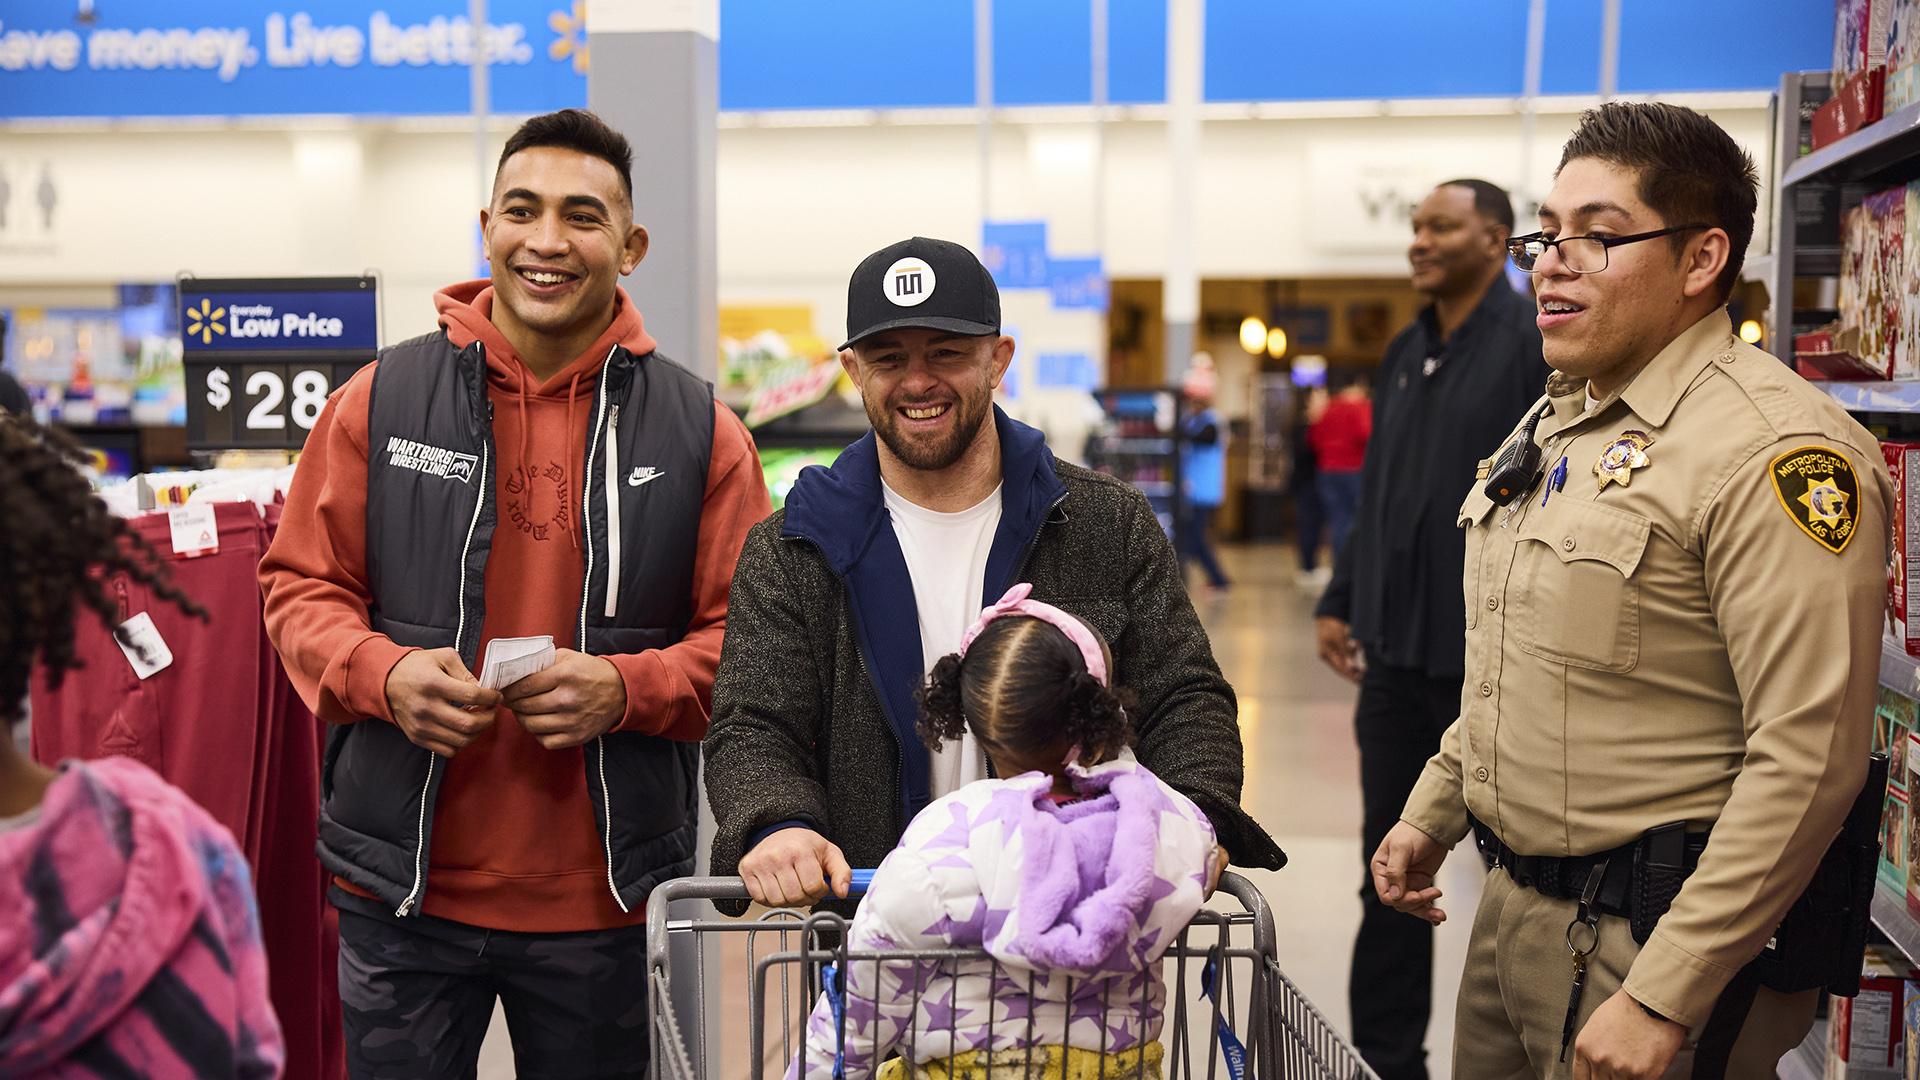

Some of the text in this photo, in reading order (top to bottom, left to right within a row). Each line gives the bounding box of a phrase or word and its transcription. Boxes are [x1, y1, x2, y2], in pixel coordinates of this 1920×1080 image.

[0, 10, 533, 83] ave money. Live better.
[230, 304, 273, 317] Everyday
[230, 312, 343, 338] Low Price
[245, 370, 329, 430] 28
[386, 436, 454, 465] WARTBURG
[389, 452, 448, 477] WRESTLING
[633, 466, 656, 479] NIKE
[1777, 454, 1848, 478] METROPOLITAN
[1798, 463, 1834, 477] POLICE
[1810, 519, 1852, 540] LAS VEGAS
